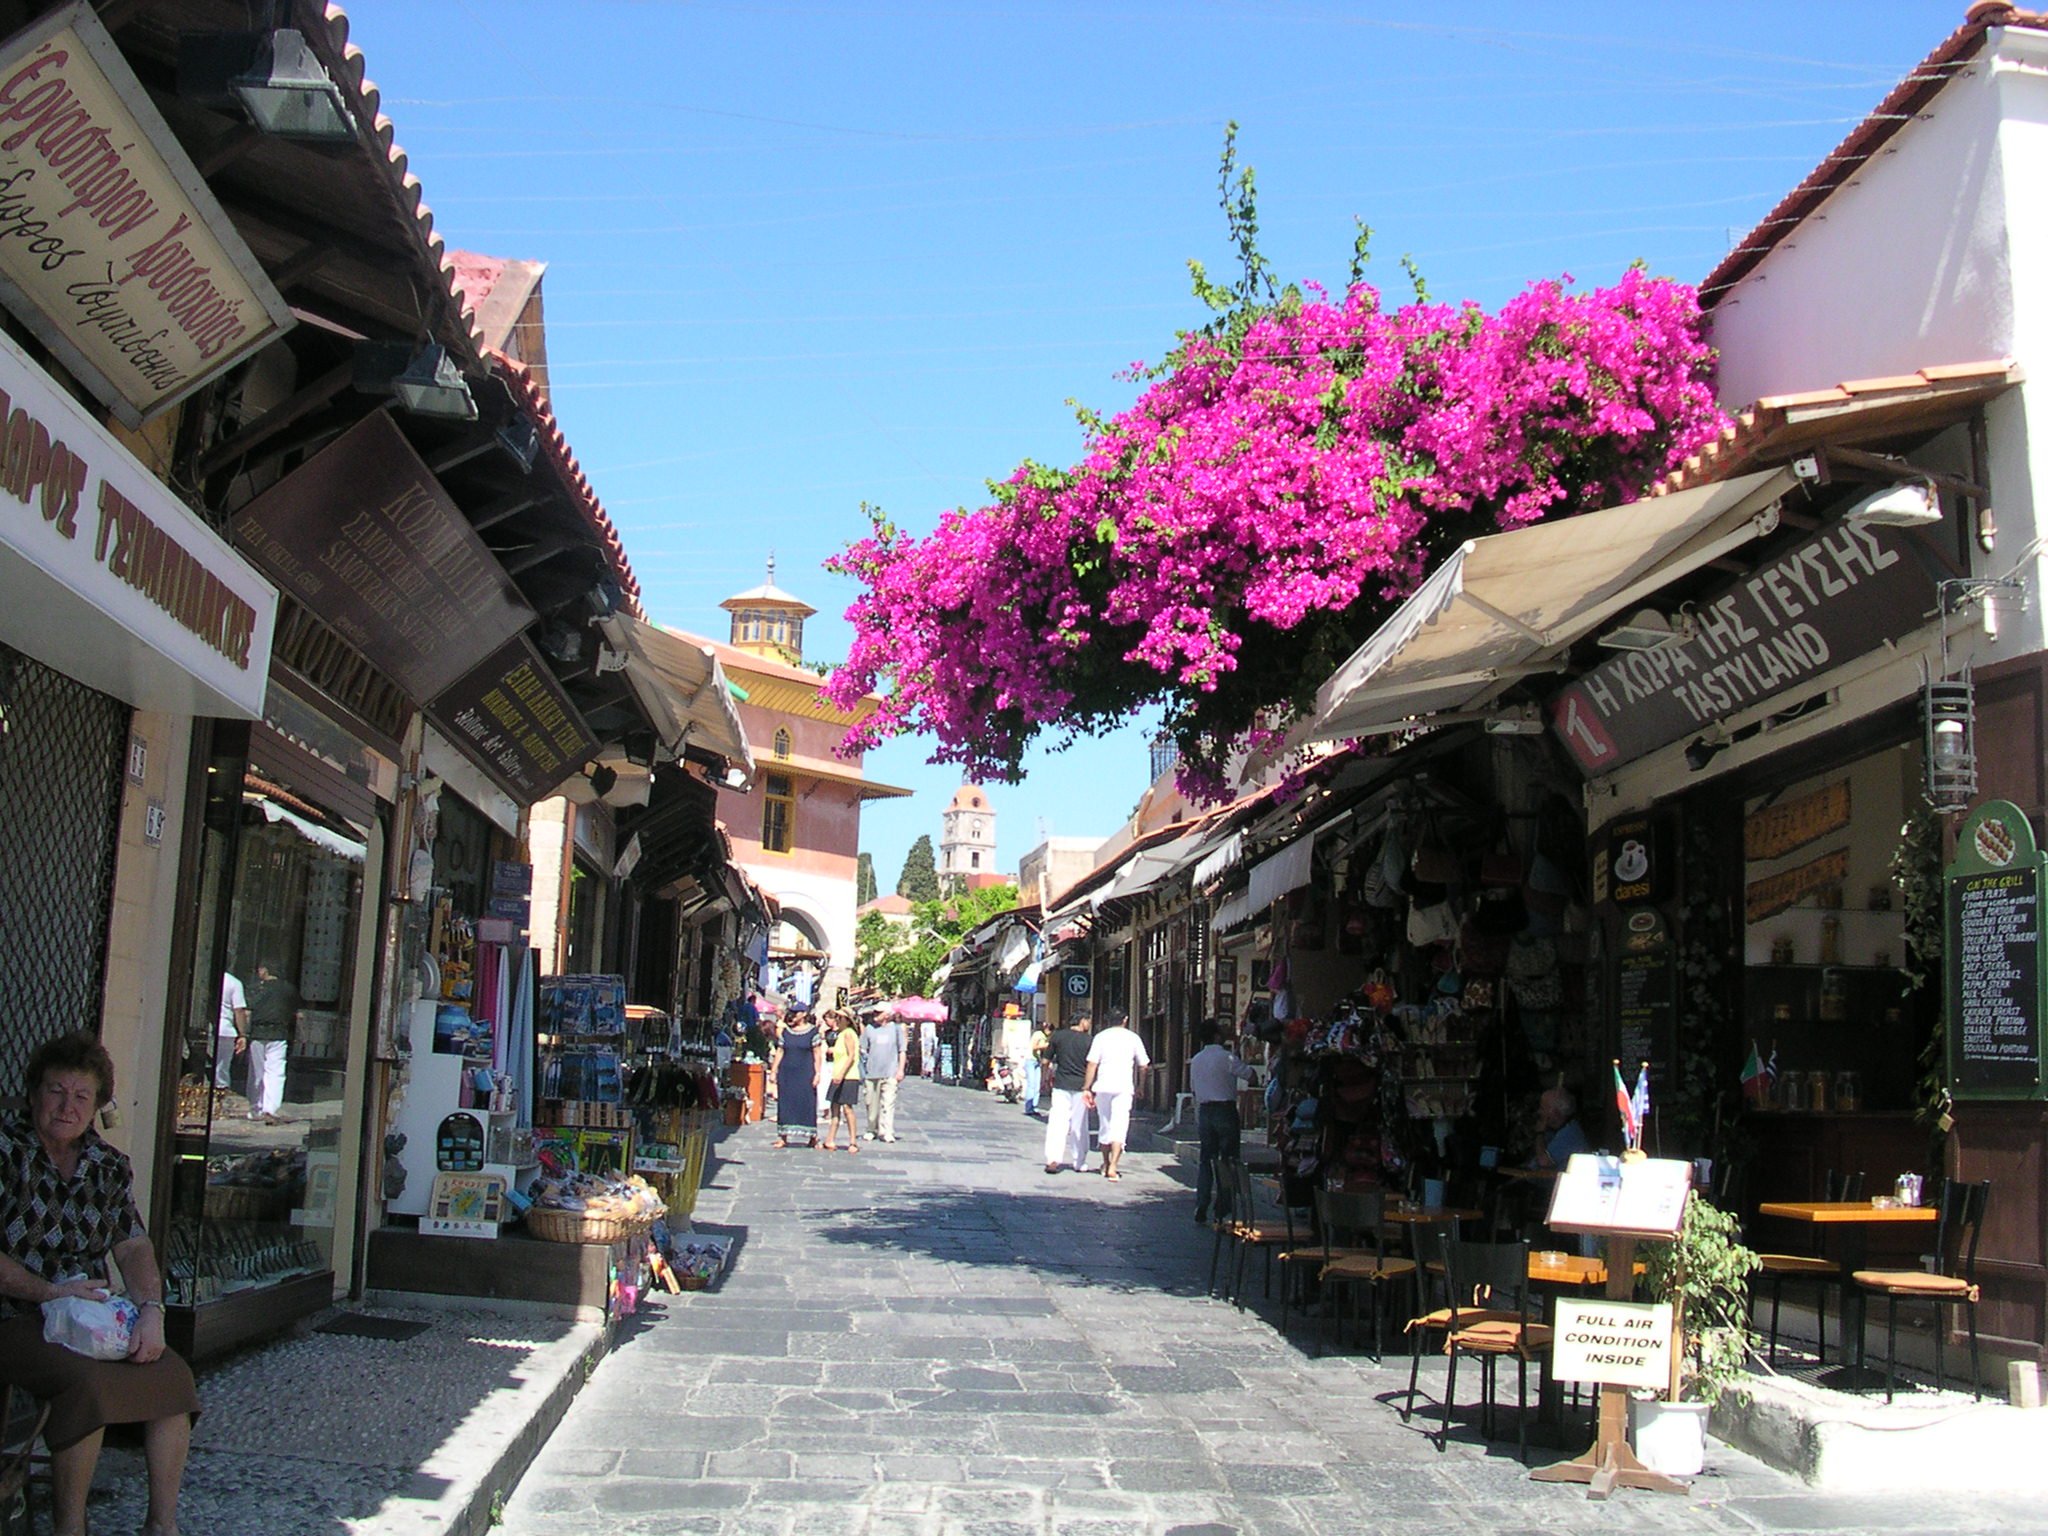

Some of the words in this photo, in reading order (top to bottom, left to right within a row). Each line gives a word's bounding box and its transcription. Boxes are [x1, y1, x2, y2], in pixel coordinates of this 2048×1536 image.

[1584, 673, 1621, 718] Η
[1608, 645, 1697, 706] ΧΩΡΑ
[1696, 595, 1760, 661] ΤΗΣ
[1746, 522, 1900, 627] ΓΕΥΣΗΣ
[1672, 622, 1830, 722] TASTYLAND
[1575, 1314, 1617, 1328] FULL
[1624, 1318, 1654, 1330] AIR
[1564, 1332, 1664, 1350] CONDITION
[1584, 1352, 1647, 1367] INSIDE
